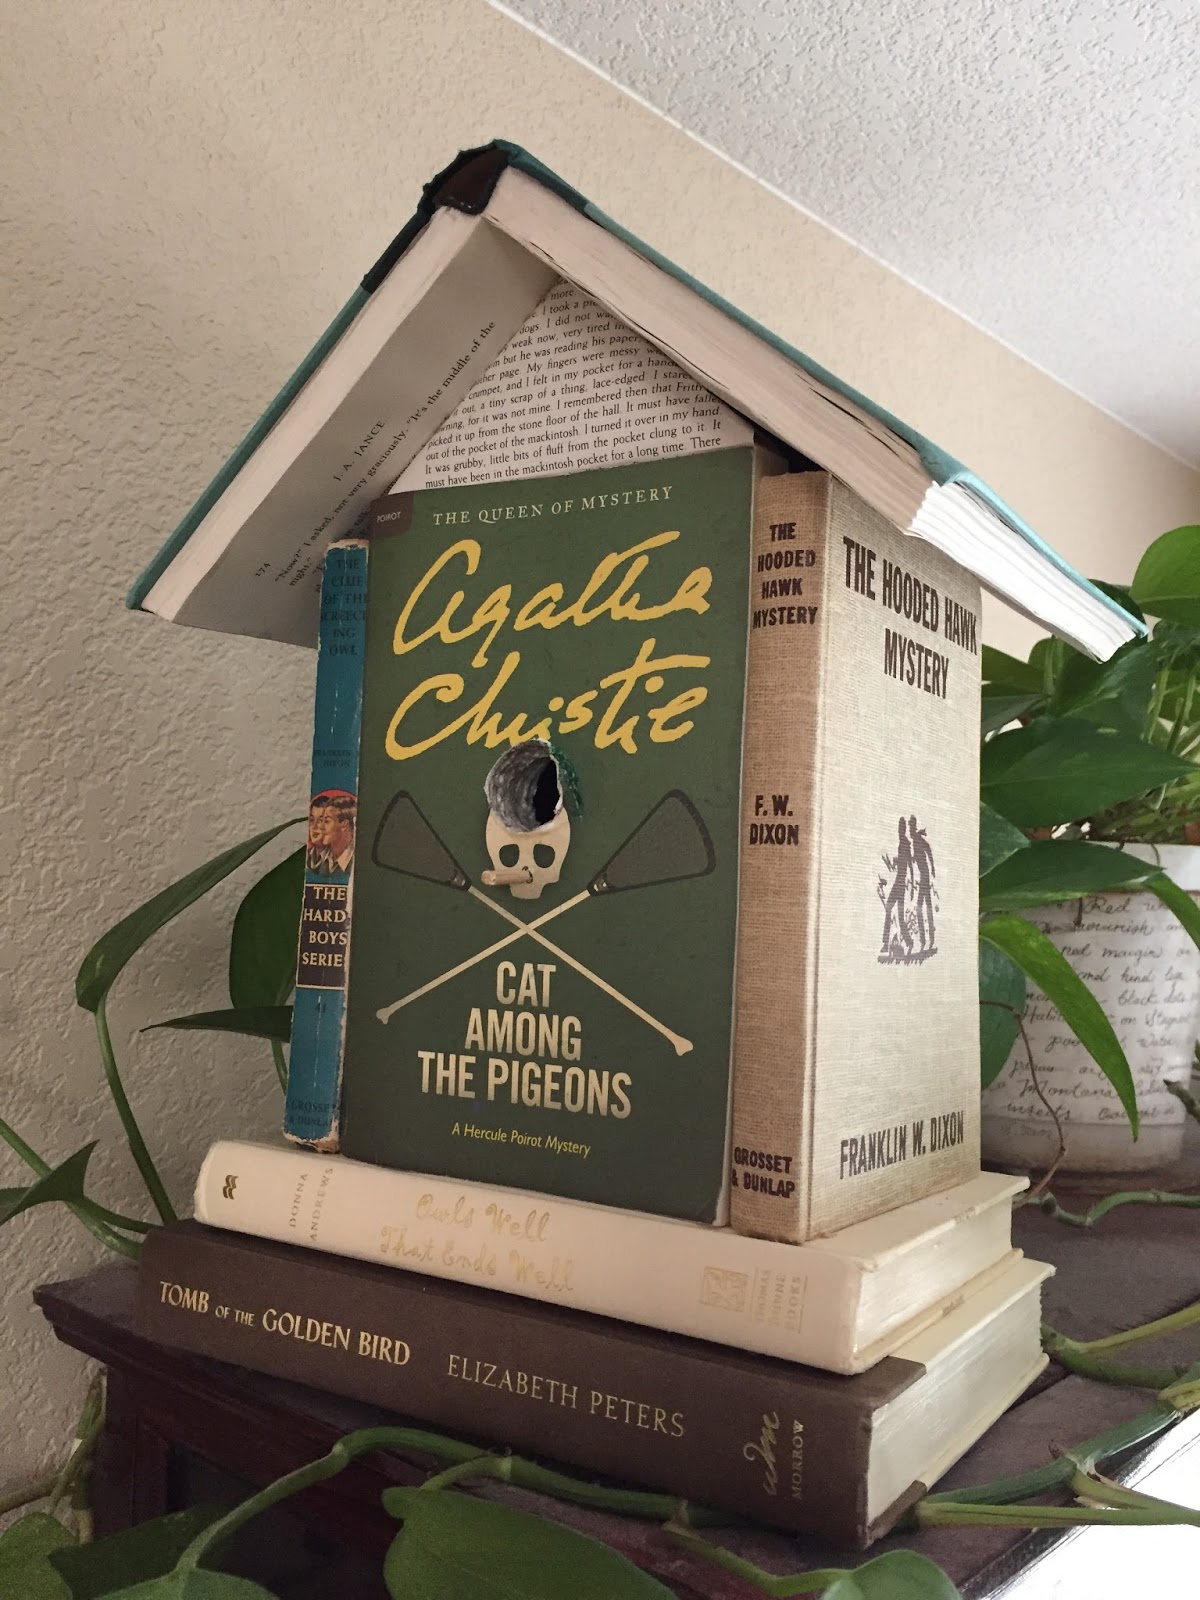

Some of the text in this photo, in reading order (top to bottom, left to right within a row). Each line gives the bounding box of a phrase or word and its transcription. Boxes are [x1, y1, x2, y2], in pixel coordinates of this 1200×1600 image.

[348, 478, 368, 498] very
[427, 389, 443, 405] the
[443, 355, 472, 388] middle
[470, 339, 481, 353] of
[480, 322, 496, 339] the
[428, 434, 453, 450] picked
[456, 434, 462, 442] it
[464, 432, 476, 442] up
[478, 426, 499, 439] from
[502, 423, 516, 434] the
[518, 420, 543, 431] stone
[546, 416, 567, 427] floor
[570, 412, 581, 422] of
[584, 408, 599, 420] the
[626, 402, 634, 413] It
[638, 400, 661, 411] must
[666, 396, 690, 407] have
[694, 394, 721, 404] falle
[482, 414, 489, 423] it
[492, 412, 508, 421] was
[511, 408, 526, 418] not
[564, 391, 622, 408] remembered
[625, 387, 648, 398] then
[652, 384, 672, 394] that
[354, 420, 386, 457] JANCE
[426, 452, 440, 462] out
[441, 449, 451, 459] of
[452, 446, 466, 457] the
[468, 442, 497, 456] pocket
[500, 438, 510, 449] of
[511, 436, 525, 446] the
[591, 420, 622, 433] turned
[625, 418, 632, 428] it
[634, 416, 657, 426] over
[660, 413, 669, 422] in
[672, 411, 689, 422] my
[426, 464, 432, 475] It
[435, 464, 451, 473] was
[490, 454, 510, 465] little
[514, 451, 530, 461] bits
[533, 447, 543, 459] of
[546, 444, 564, 456] fluff
[568, 441, 590, 453] from
[594, 437, 609, 448] the
[613, 432, 645, 446] pocket
[650, 428, 677, 439] clung
[682, 426, 692, 435] to
[713, 420, 721, 430] It
[425, 478, 445, 489] must
[448, 475, 468, 486] have
[470, 471, 491, 483] been
[494, 469, 502, 479] in
[506, 466, 520, 477] the
[522, 456, 574, 475] mackintosh
[578, 453, 608, 468] pocket
[612, 450, 625, 461] for
[636, 446, 660, 457] long
[690, 436, 722, 449] There
[376, 512, 402, 523] POIROT
[434, 486, 673, 525] THE QUEEN OF MYSTERY
[770, 522, 797, 542] THE
[336, 560, 360, 570] THE
[758, 550, 816, 573] HOODED
[324, 594, 339, 605] OF
[393, 531, 713, 668] Agatha
[762, 578, 803, 600] HAWK
[843, 536, 977, 655] THE HOODED HAWK
[752, 606, 818, 629] MYSTERY
[884, 628, 949, 700] MYSTERY
[385, 638, 711, 760] Christie
[750, 823, 799, 845] DIXON
[314, 887, 347, 901] THE
[304, 908, 347, 923] HARD
[309, 930, 348, 945] BOYS
[302, 952, 343, 967] SERIE
[496, 960, 556, 1007] CAT
[464, 1008, 582, 1061] AMONG
[418, 1050, 632, 1119] THE PIGEONS
[291, 1100, 336, 1113] GROSSE
[297, 1116, 329, 1127] DUNLA
[452, 1122, 591, 1159] A Hercule Poirot Mystery
[840, 1124, 907, 1180] FRANKLIN
[912, 1120, 926, 1157] W.
[931, 1110, 964, 1152] DIXON
[734, 1147, 793, 1174] GROSSET
[289, 1174, 308, 1228] DONNA
[732, 1169, 795, 1198] & DUNLAP
[310, 1168, 333, 1241] ANDREWS
[416, 1194, 550, 1242] Owls Well
[380, 1225, 434, 1262] That
[160, 1281, 411, 1365] TOMB OF THE GOLDEN BIRD
[447, 1354, 685, 1438] ELIZABETH PETERS
[792, 1420, 804, 1500] MORROW
